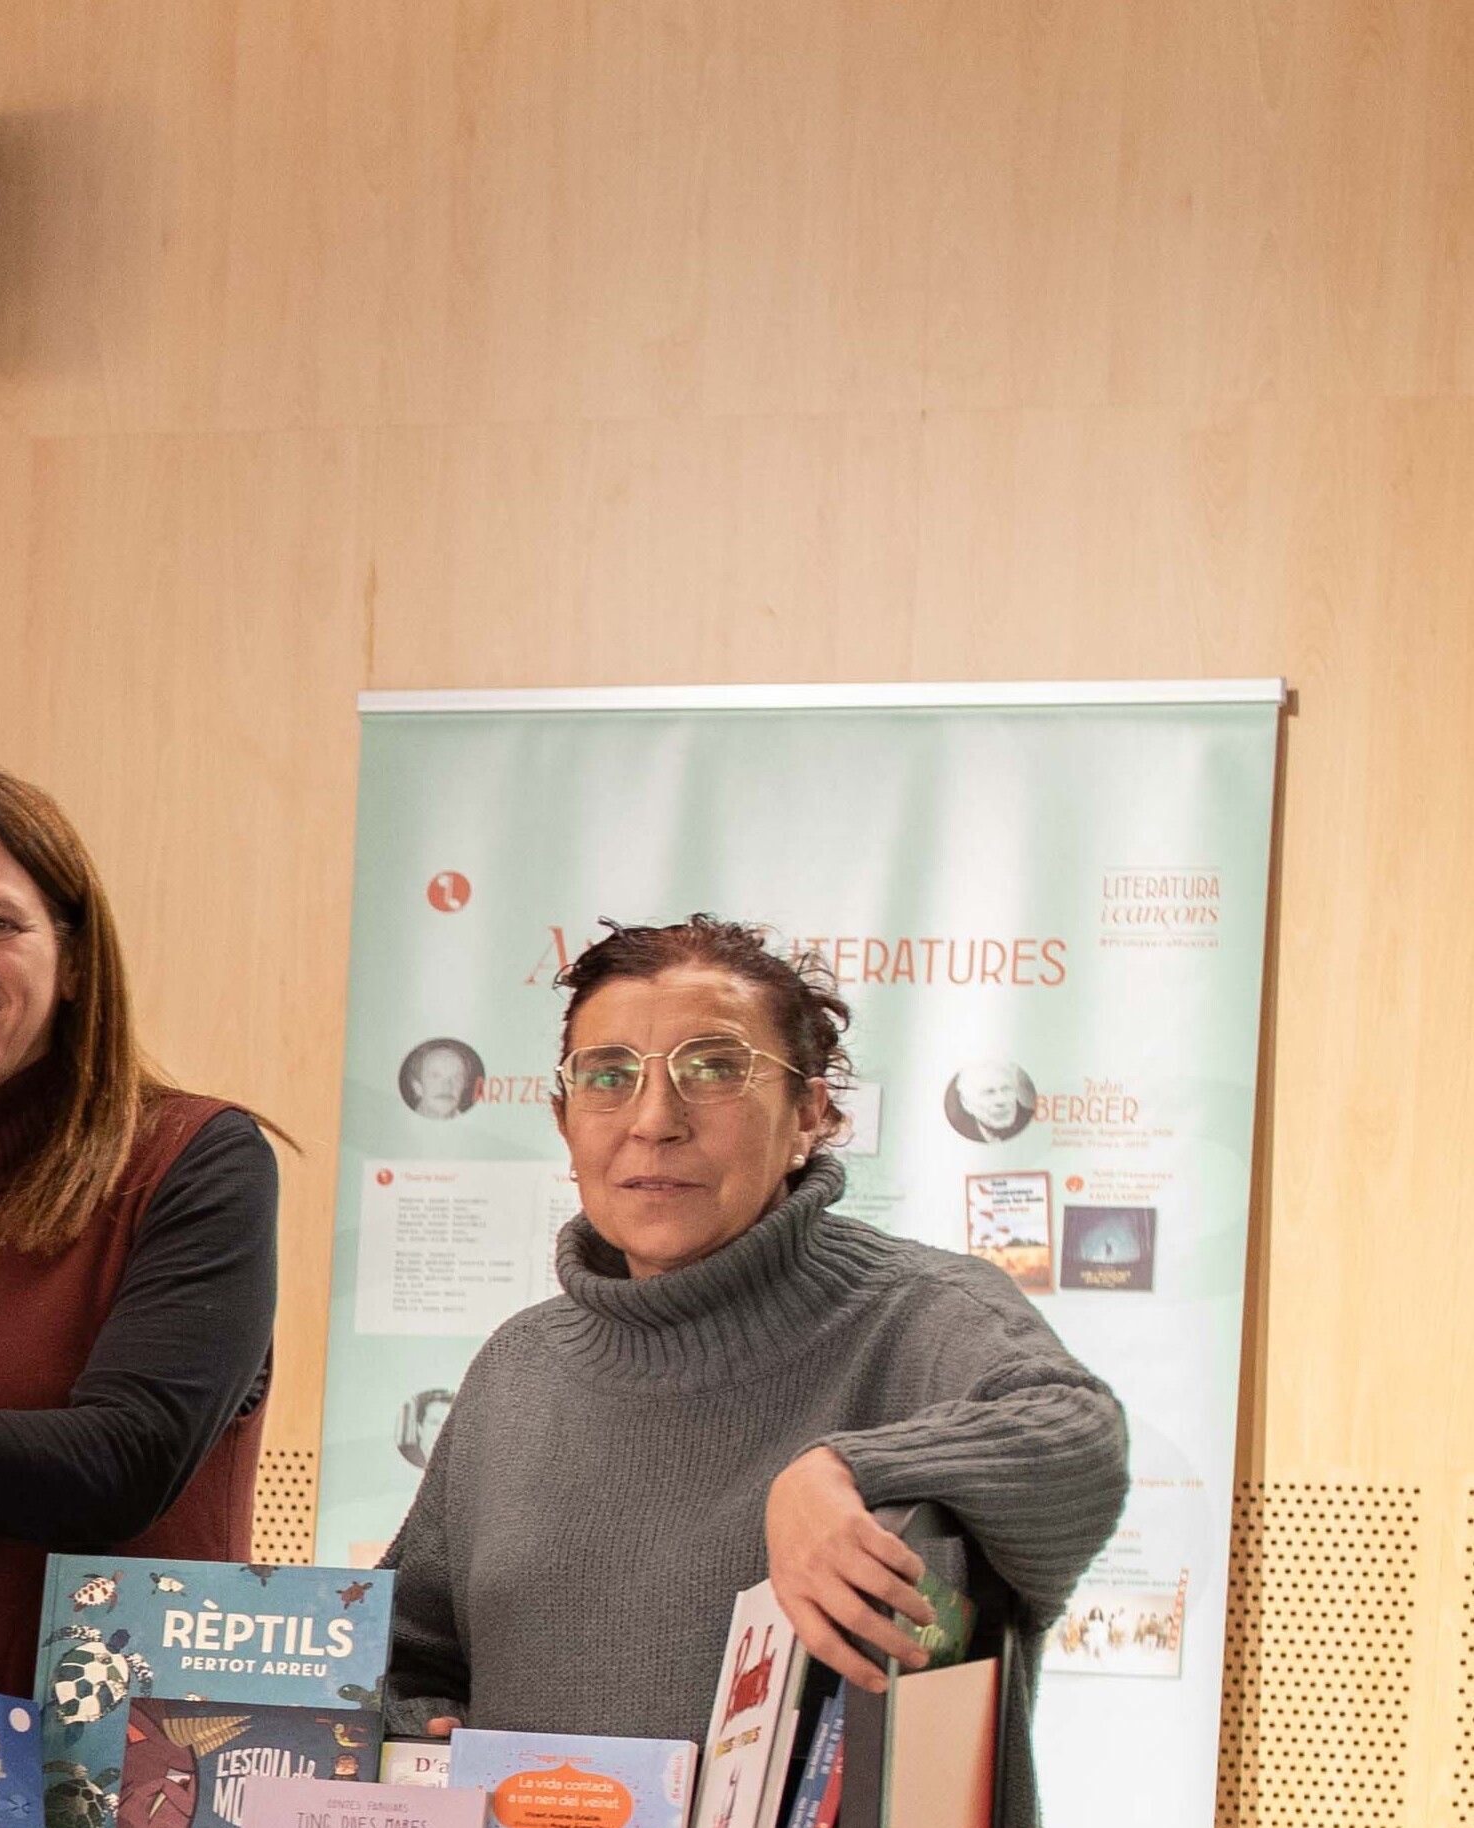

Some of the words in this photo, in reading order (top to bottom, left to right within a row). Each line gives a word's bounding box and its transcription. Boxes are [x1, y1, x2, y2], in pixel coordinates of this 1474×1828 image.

[1102, 875, 1221, 900] LITERATURA
[787, 935, 1067, 988] ITERATURES
[1035, 1097, 1140, 1124] BERGER
[161, 1598, 355, 1658] RÈPTILS
[181, 1656, 256, 1675] PERTOT
[261, 1660, 328, 1678] ARREU
[518, 1776, 534, 1790] La
[536, 1778, 563, 1790] vida
[564, 1779, 614, 1792] contada
